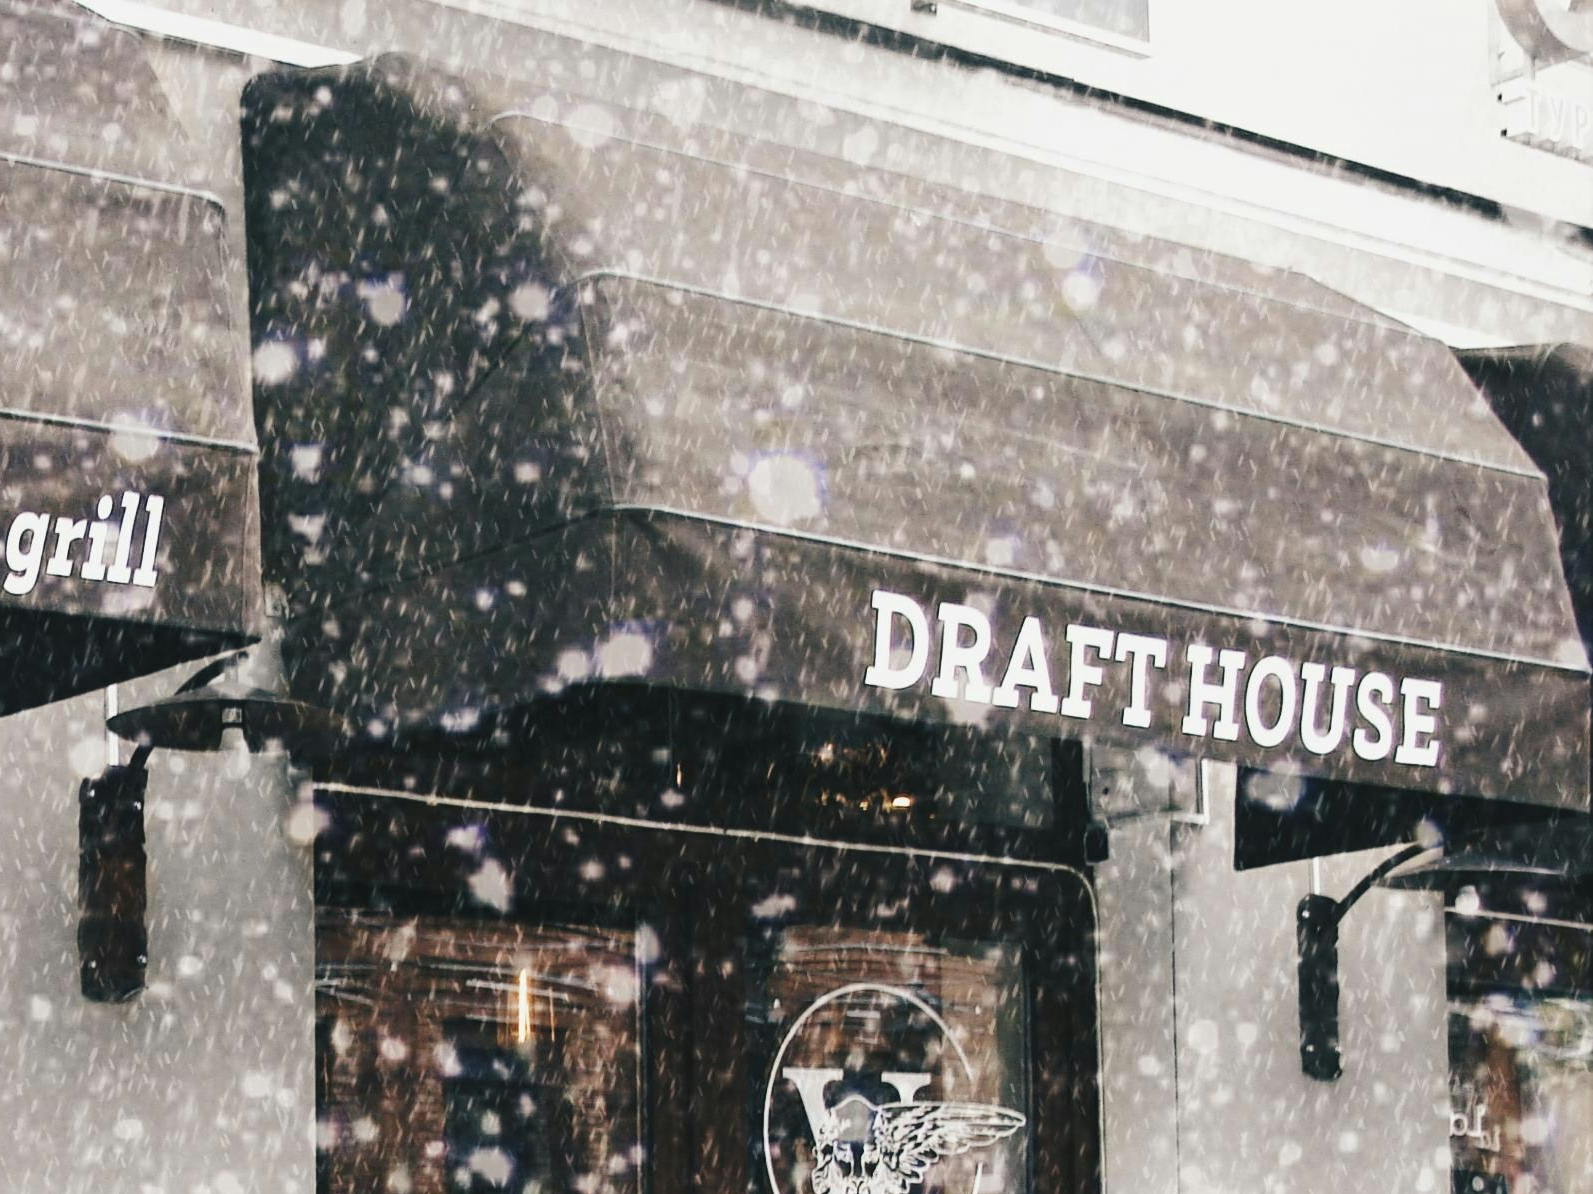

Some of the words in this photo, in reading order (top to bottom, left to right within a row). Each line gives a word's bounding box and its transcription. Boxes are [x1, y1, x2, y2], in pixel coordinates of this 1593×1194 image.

[3, 491, 166, 596] grill
[865, 590, 1166, 729] DRAFT
[1182, 644, 1443, 767] HOUSE
